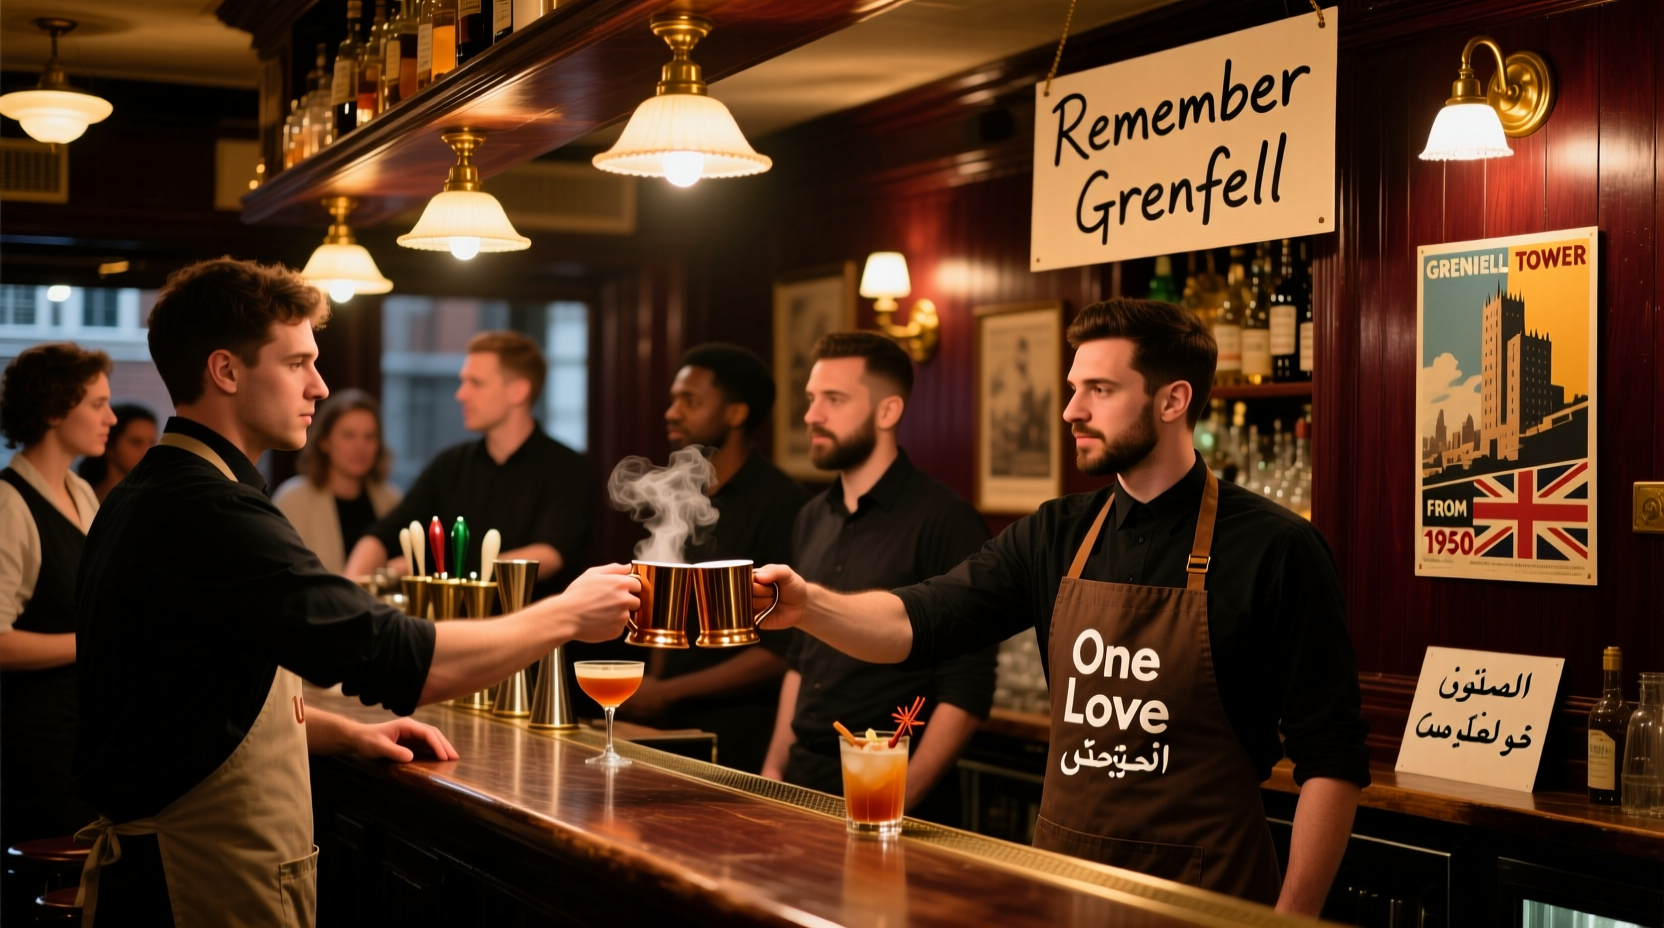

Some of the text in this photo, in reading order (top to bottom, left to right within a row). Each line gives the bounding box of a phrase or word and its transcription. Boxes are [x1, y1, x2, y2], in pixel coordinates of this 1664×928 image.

[1052, 58, 1311, 167] Remember
[1076, 131, 1287, 246] Grenfell
[1515, 245, 1587, 272] TOWER
[1427, 496, 1467, 518] FROM
[1424, 529, 1474, 556] 1950
[1072, 628, 1161, 682] One
[1063, 676, 1169, 734] Love
